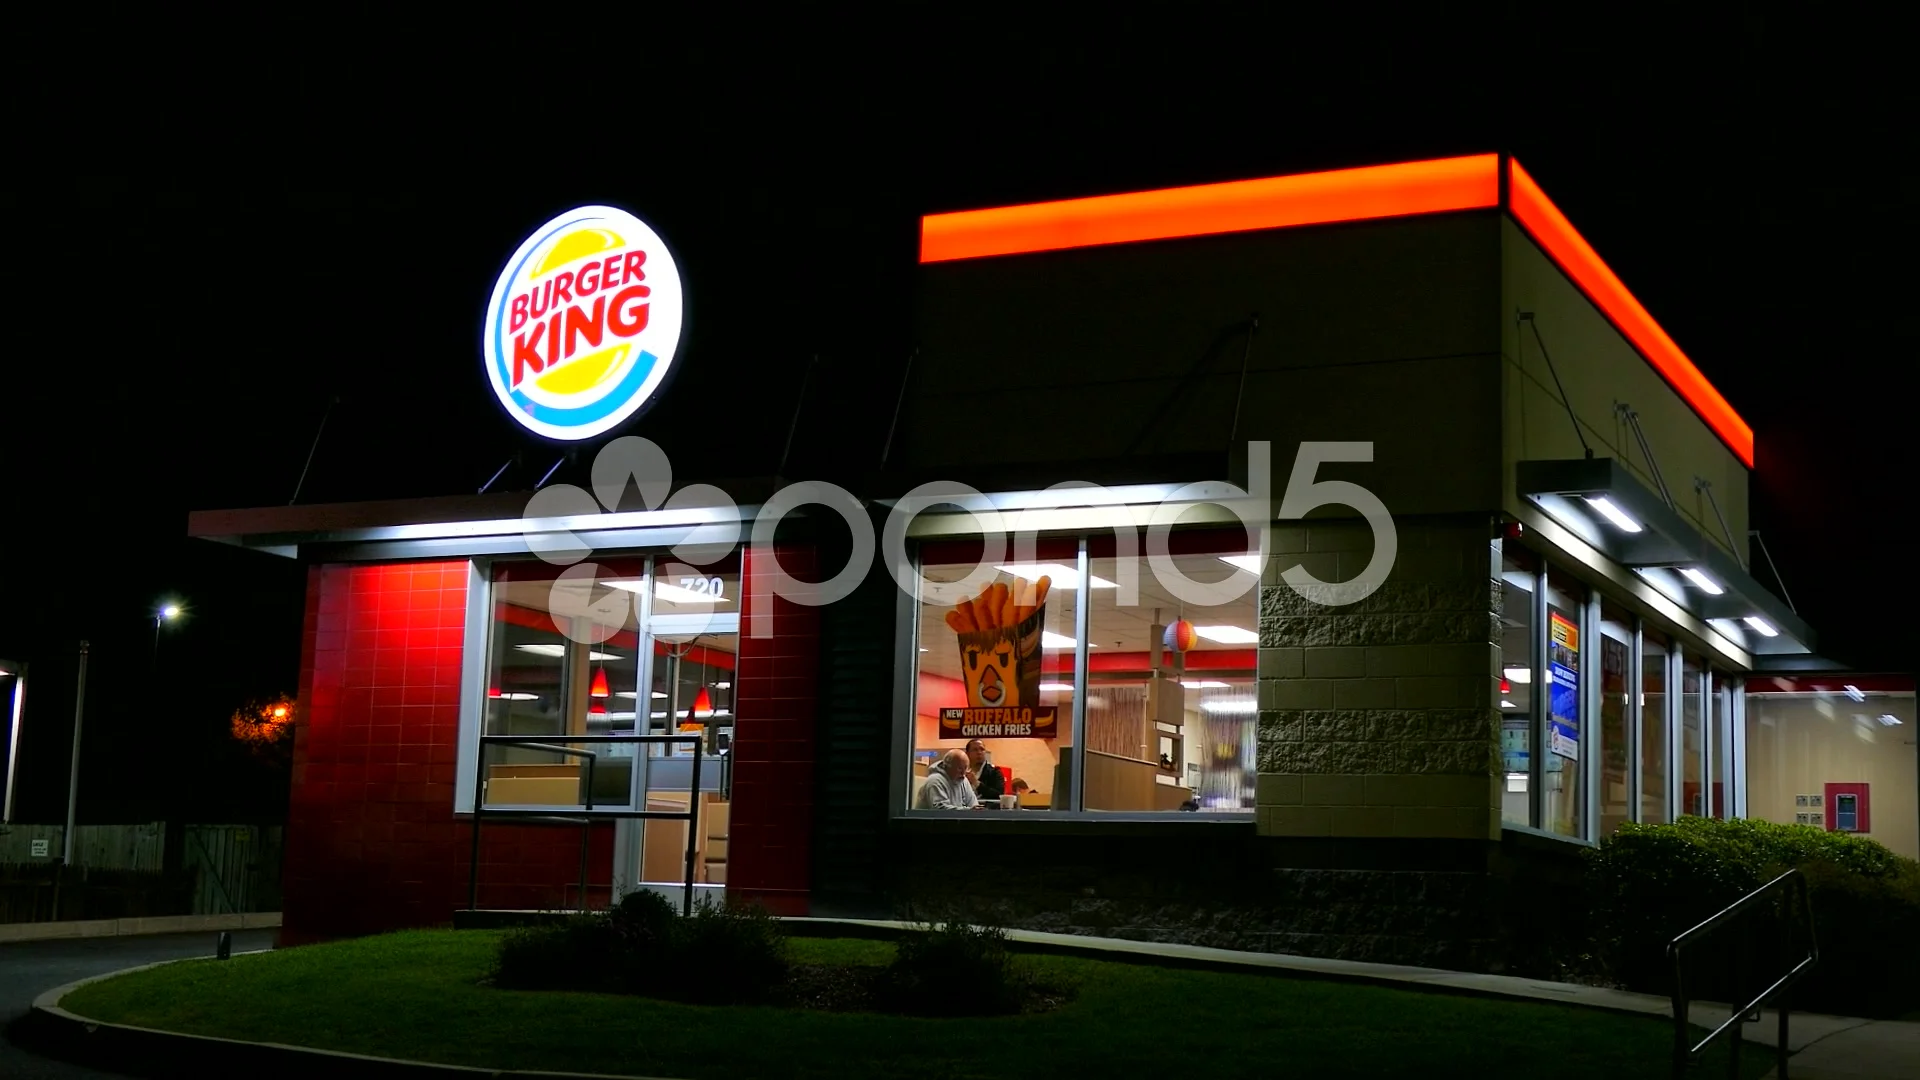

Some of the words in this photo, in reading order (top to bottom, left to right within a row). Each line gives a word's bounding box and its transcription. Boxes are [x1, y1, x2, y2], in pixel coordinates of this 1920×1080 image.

[510, 250, 647, 334] BURGER
[513, 285, 651, 387] KING
[680, 577, 724, 598] 720
[946, 709, 963, 719] NEW
[964, 708, 1032, 724] BUFFALO
[962, 724, 1002, 736] CHICKEN
[1004, 723, 1031, 735] FRIES
